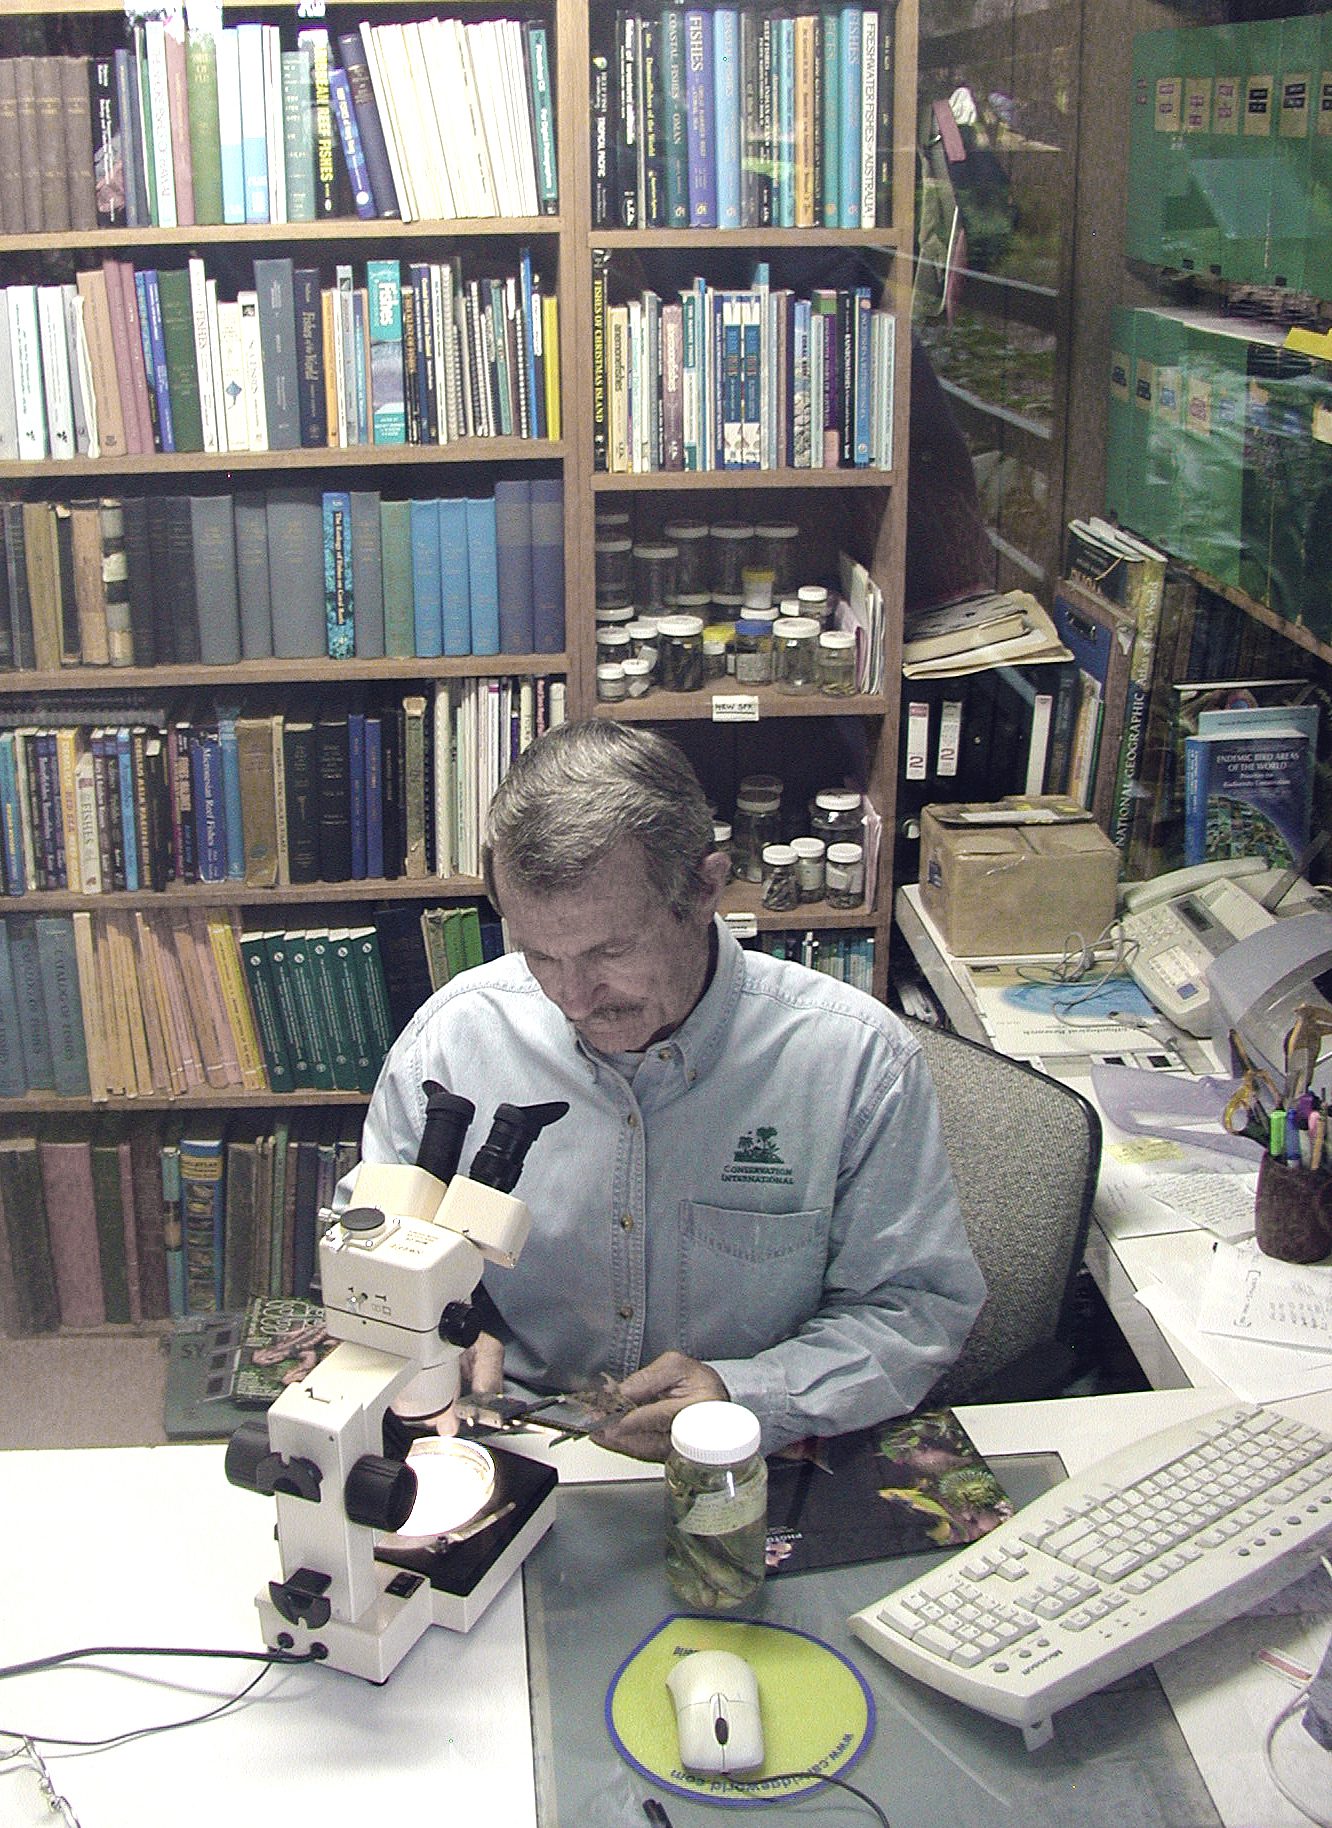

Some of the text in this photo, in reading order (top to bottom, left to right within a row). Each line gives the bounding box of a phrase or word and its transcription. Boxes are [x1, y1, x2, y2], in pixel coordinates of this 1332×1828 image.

[690, 16, 704, 72] FISHES
[864, 23, 876, 102] FRESHWATER
[668, 13, 682, 145] COASTAL FISHES OMAN
[317, 107, 331, 138] REEF
[865, 103, 875, 143] FISHES
[319, 139, 334, 182] FISHES
[865, 153, 874, 213] AUSTRALIA
[303, 311, 315, 338] Fishes
[378, 282, 399, 326] Fishes
[304, 355, 318, 381] World
[594, 279, 604, 423] FISHES OF CHRISTMAS ISLAND
[614, 324, 625, 392] anemonefishes
[666, 323, 679, 392] anemonefishes
[909, 756, 923, 769] 2
[940, 748, 955, 761] 2
[1115, 693, 1146, 847] NATIONAL GEOGRAPHIC
[1217, 751, 1300, 763] ENDEMIC BIRD AREAS
[1228, 762, 1288, 772] OF THE WORLD
[202, 747, 216, 847] Micronesian Reef Fishes
[82, 803, 94, 846] FISHES
[721, 1174, 795, 1185] INTERNATIONAL
[723, 1165, 793, 1176] CONSERVATION
